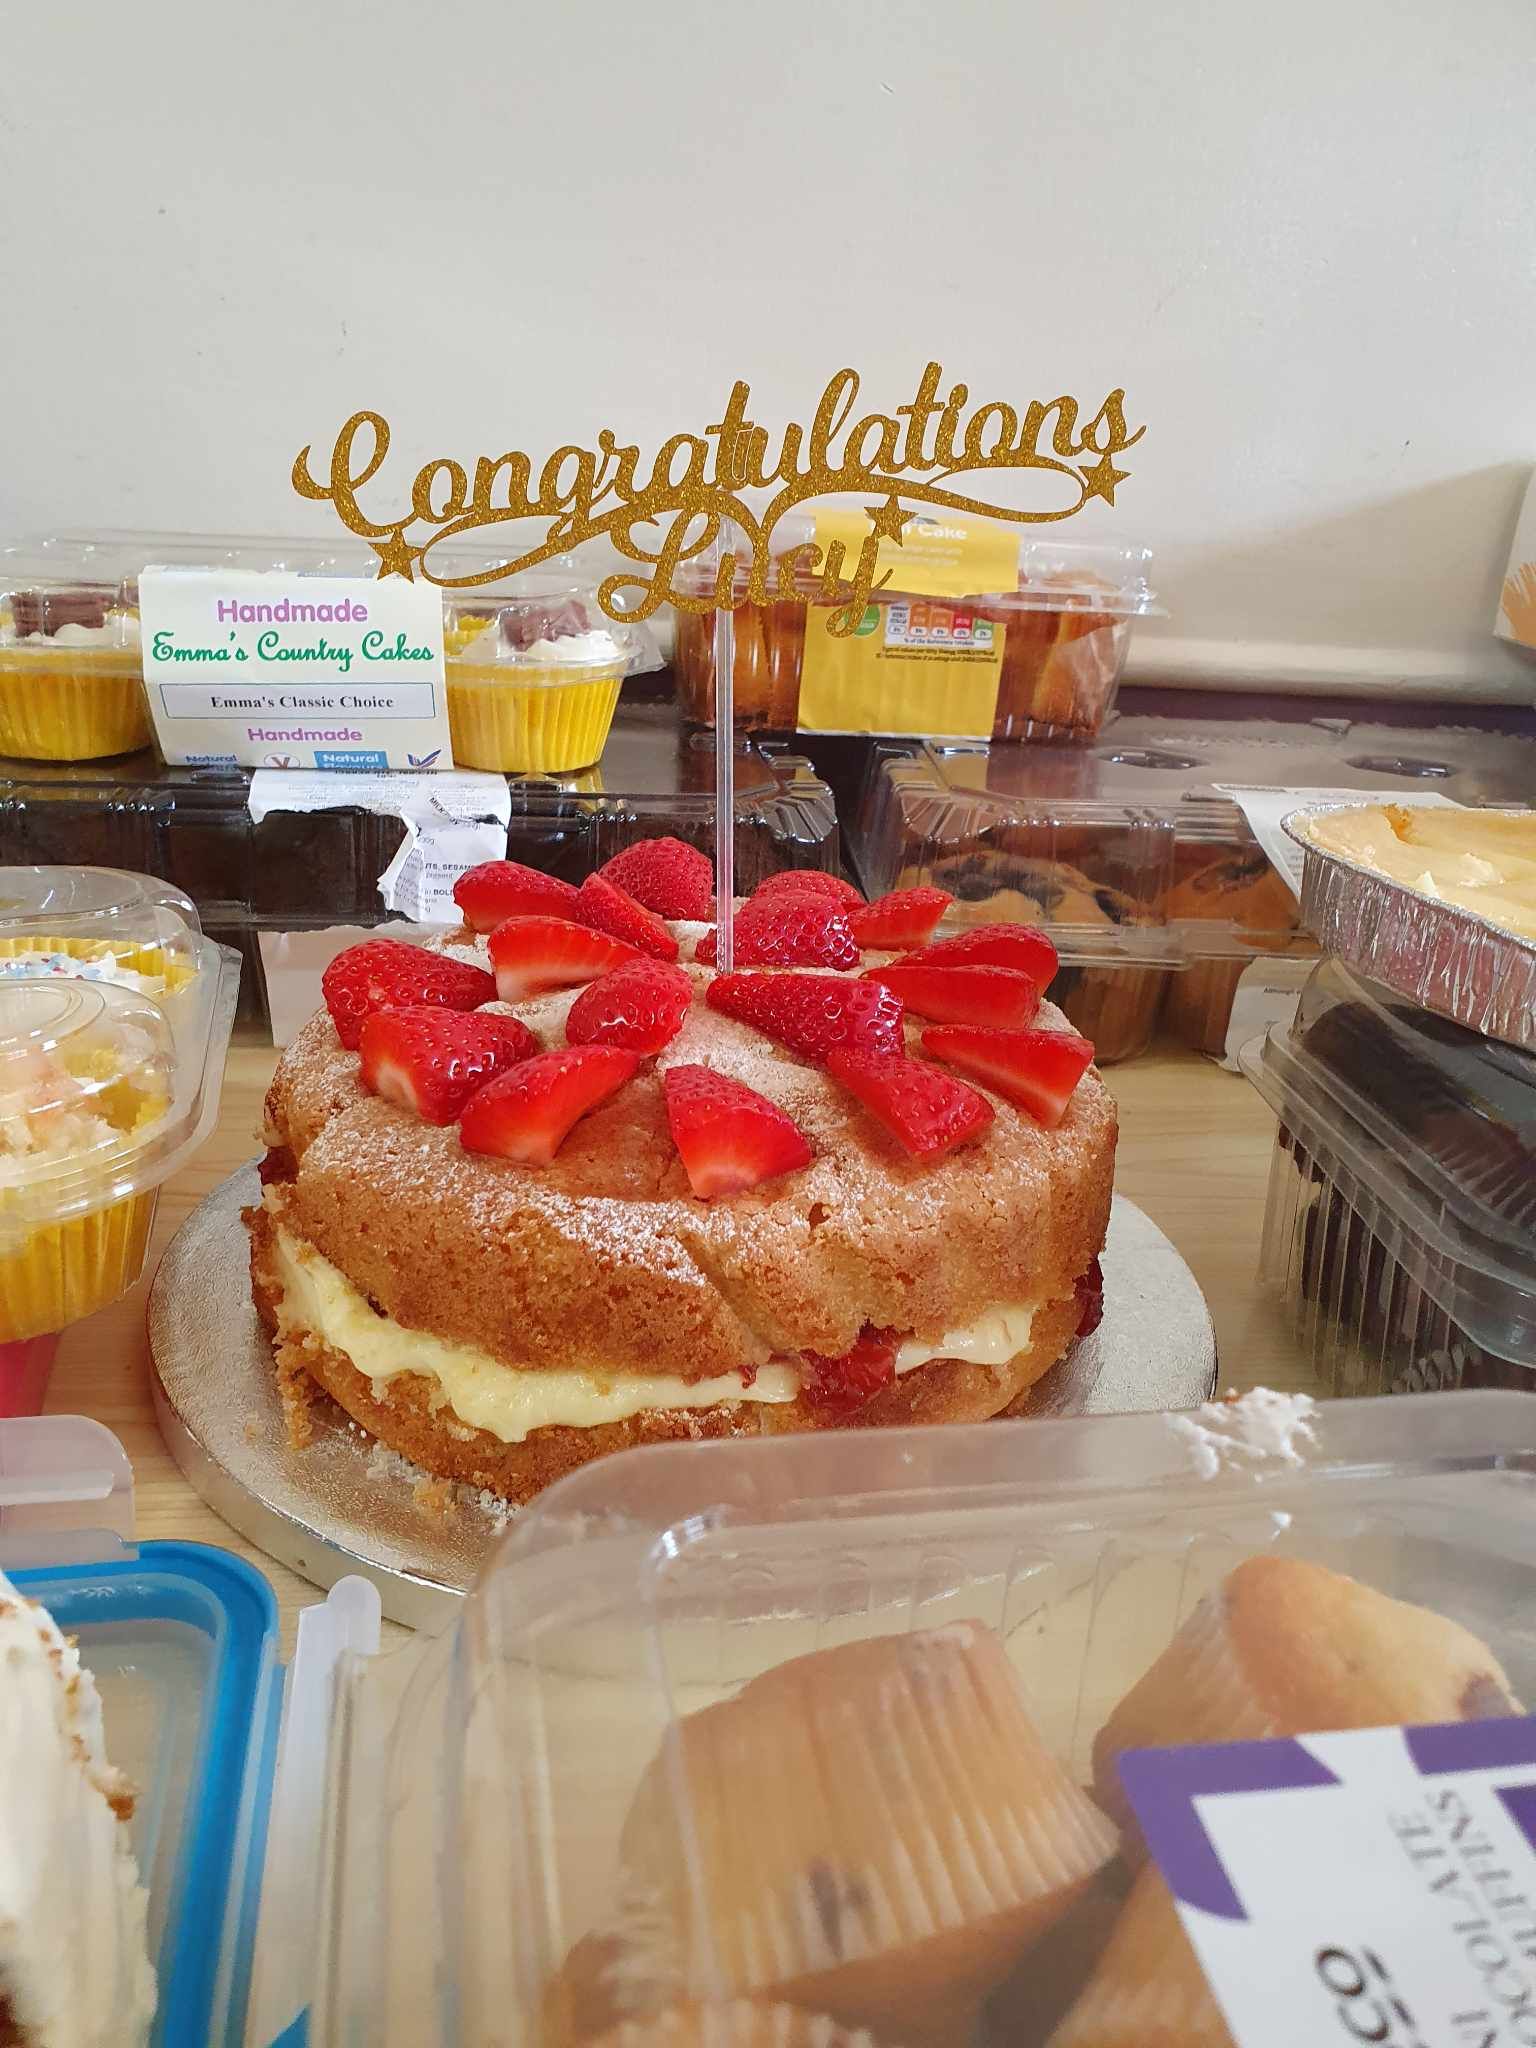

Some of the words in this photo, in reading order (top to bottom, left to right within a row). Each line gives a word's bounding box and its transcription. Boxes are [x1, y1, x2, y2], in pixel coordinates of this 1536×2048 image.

[291, 361, 1148, 548] Congratulations
[918, 525, 967, 540] Cake
[598, 506, 893, 638] Lucy
[217, 598, 368, 622] Handmade
[152, 631, 248, 662] Emma's
[257, 630, 353, 672] Country
[361, 630, 434, 661] Cakes
[210, 696, 275, 709] Emma's
[280, 696, 334, 709] Classic
[340, 695, 394, 709] Choice
[248, 728, 362, 741] Handmade
[185, 753, 238, 764] Natural
[322, 753, 380, 764] Natural
